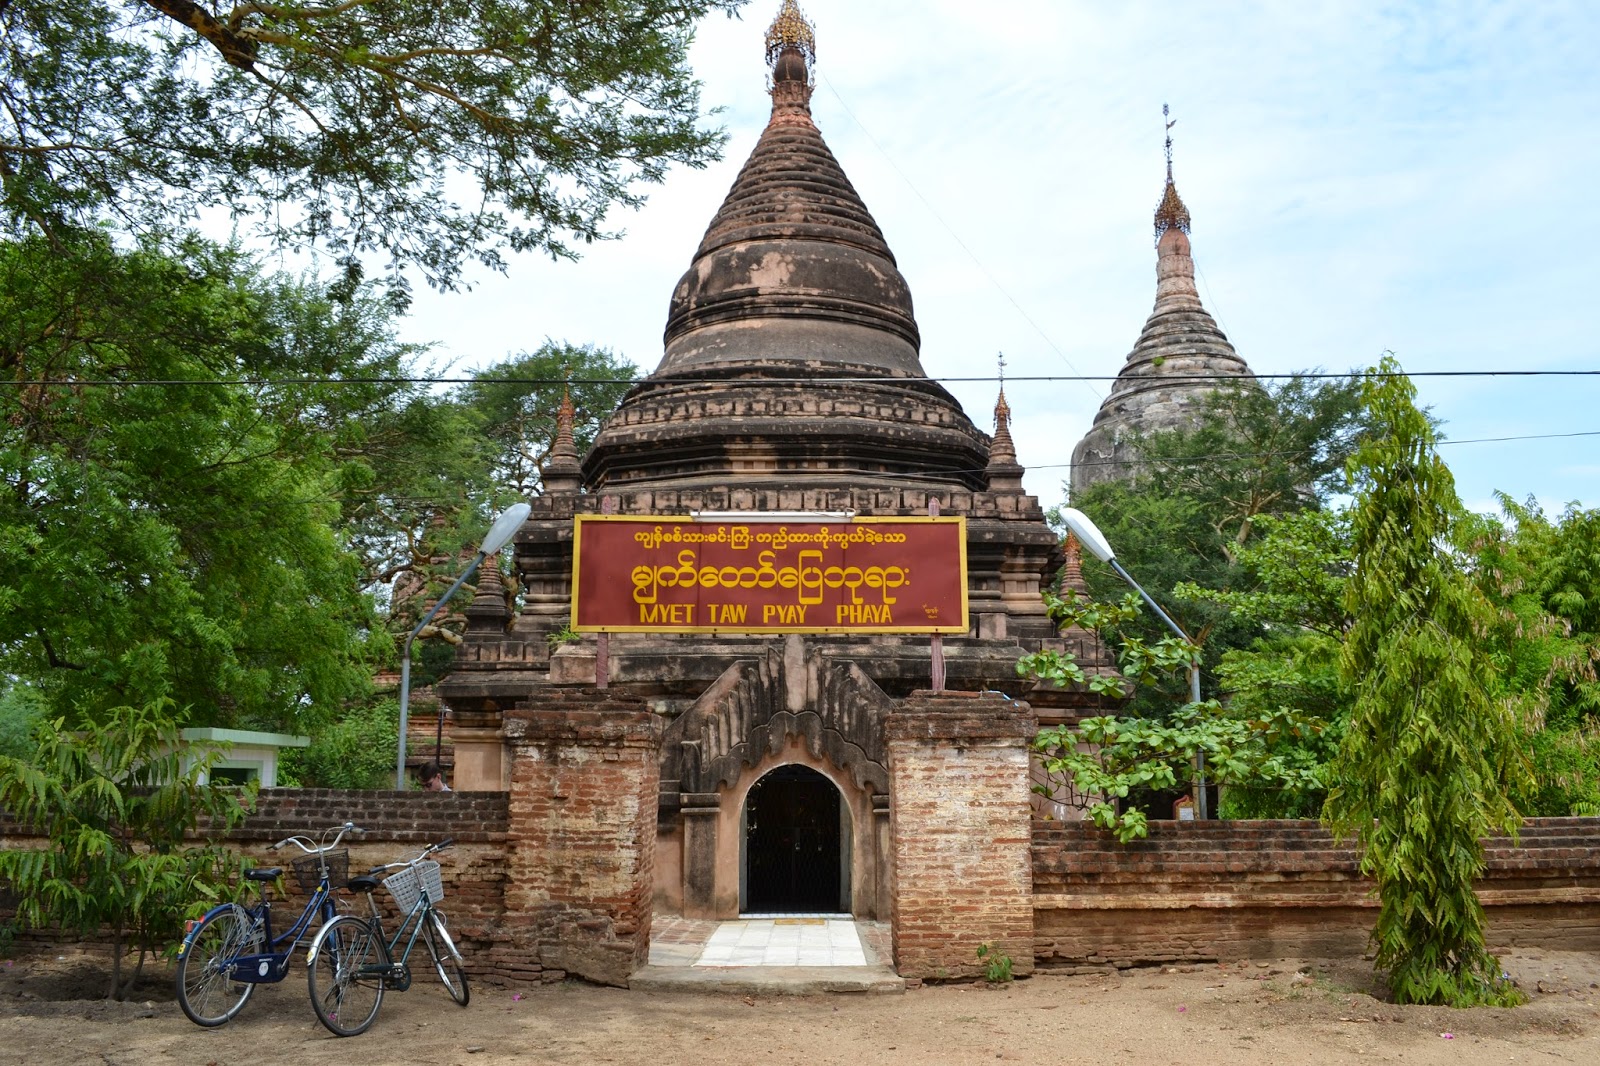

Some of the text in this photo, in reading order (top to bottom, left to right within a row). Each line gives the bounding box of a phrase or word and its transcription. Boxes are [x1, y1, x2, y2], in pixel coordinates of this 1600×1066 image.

[640, 604, 893, 623] MYET TAW PYAY PHAYA
